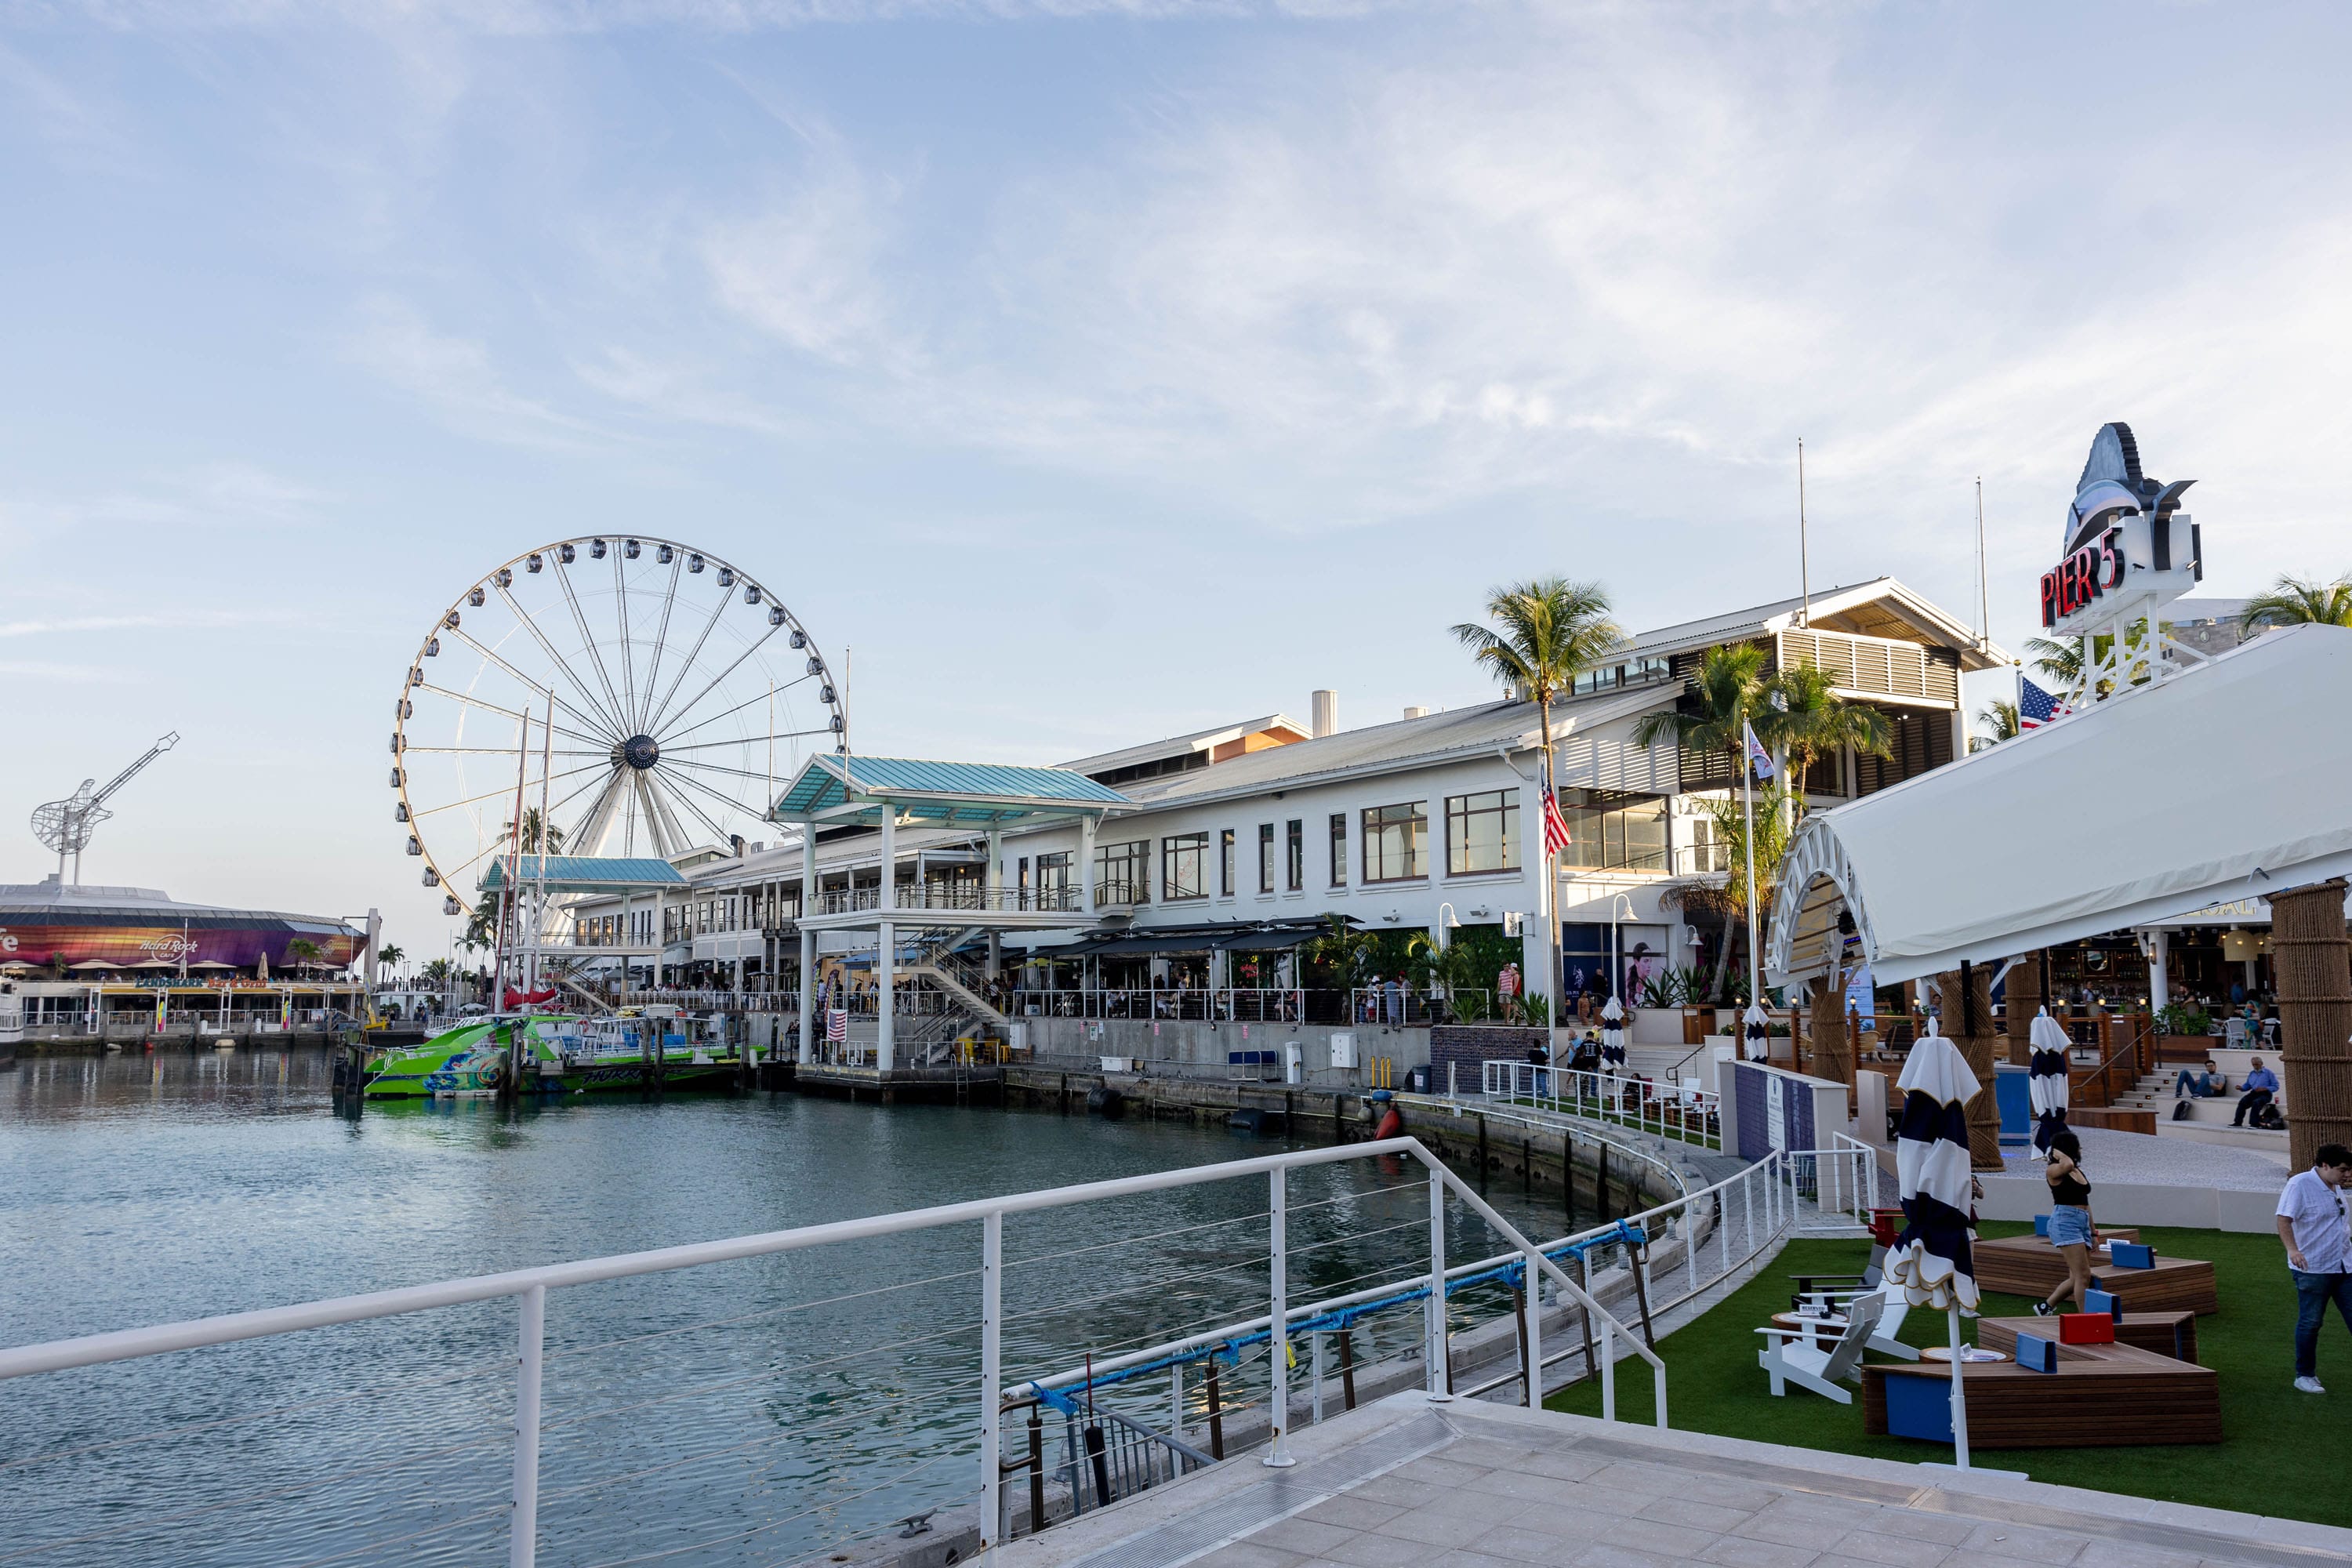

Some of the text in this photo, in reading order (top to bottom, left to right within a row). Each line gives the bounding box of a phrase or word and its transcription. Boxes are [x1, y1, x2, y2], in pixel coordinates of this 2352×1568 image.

[2041, 527, 2125, 627] PIER 5
[140, 940, 198, 953] Hard Rock
[135, 978, 203, 989] LANDSHARK
